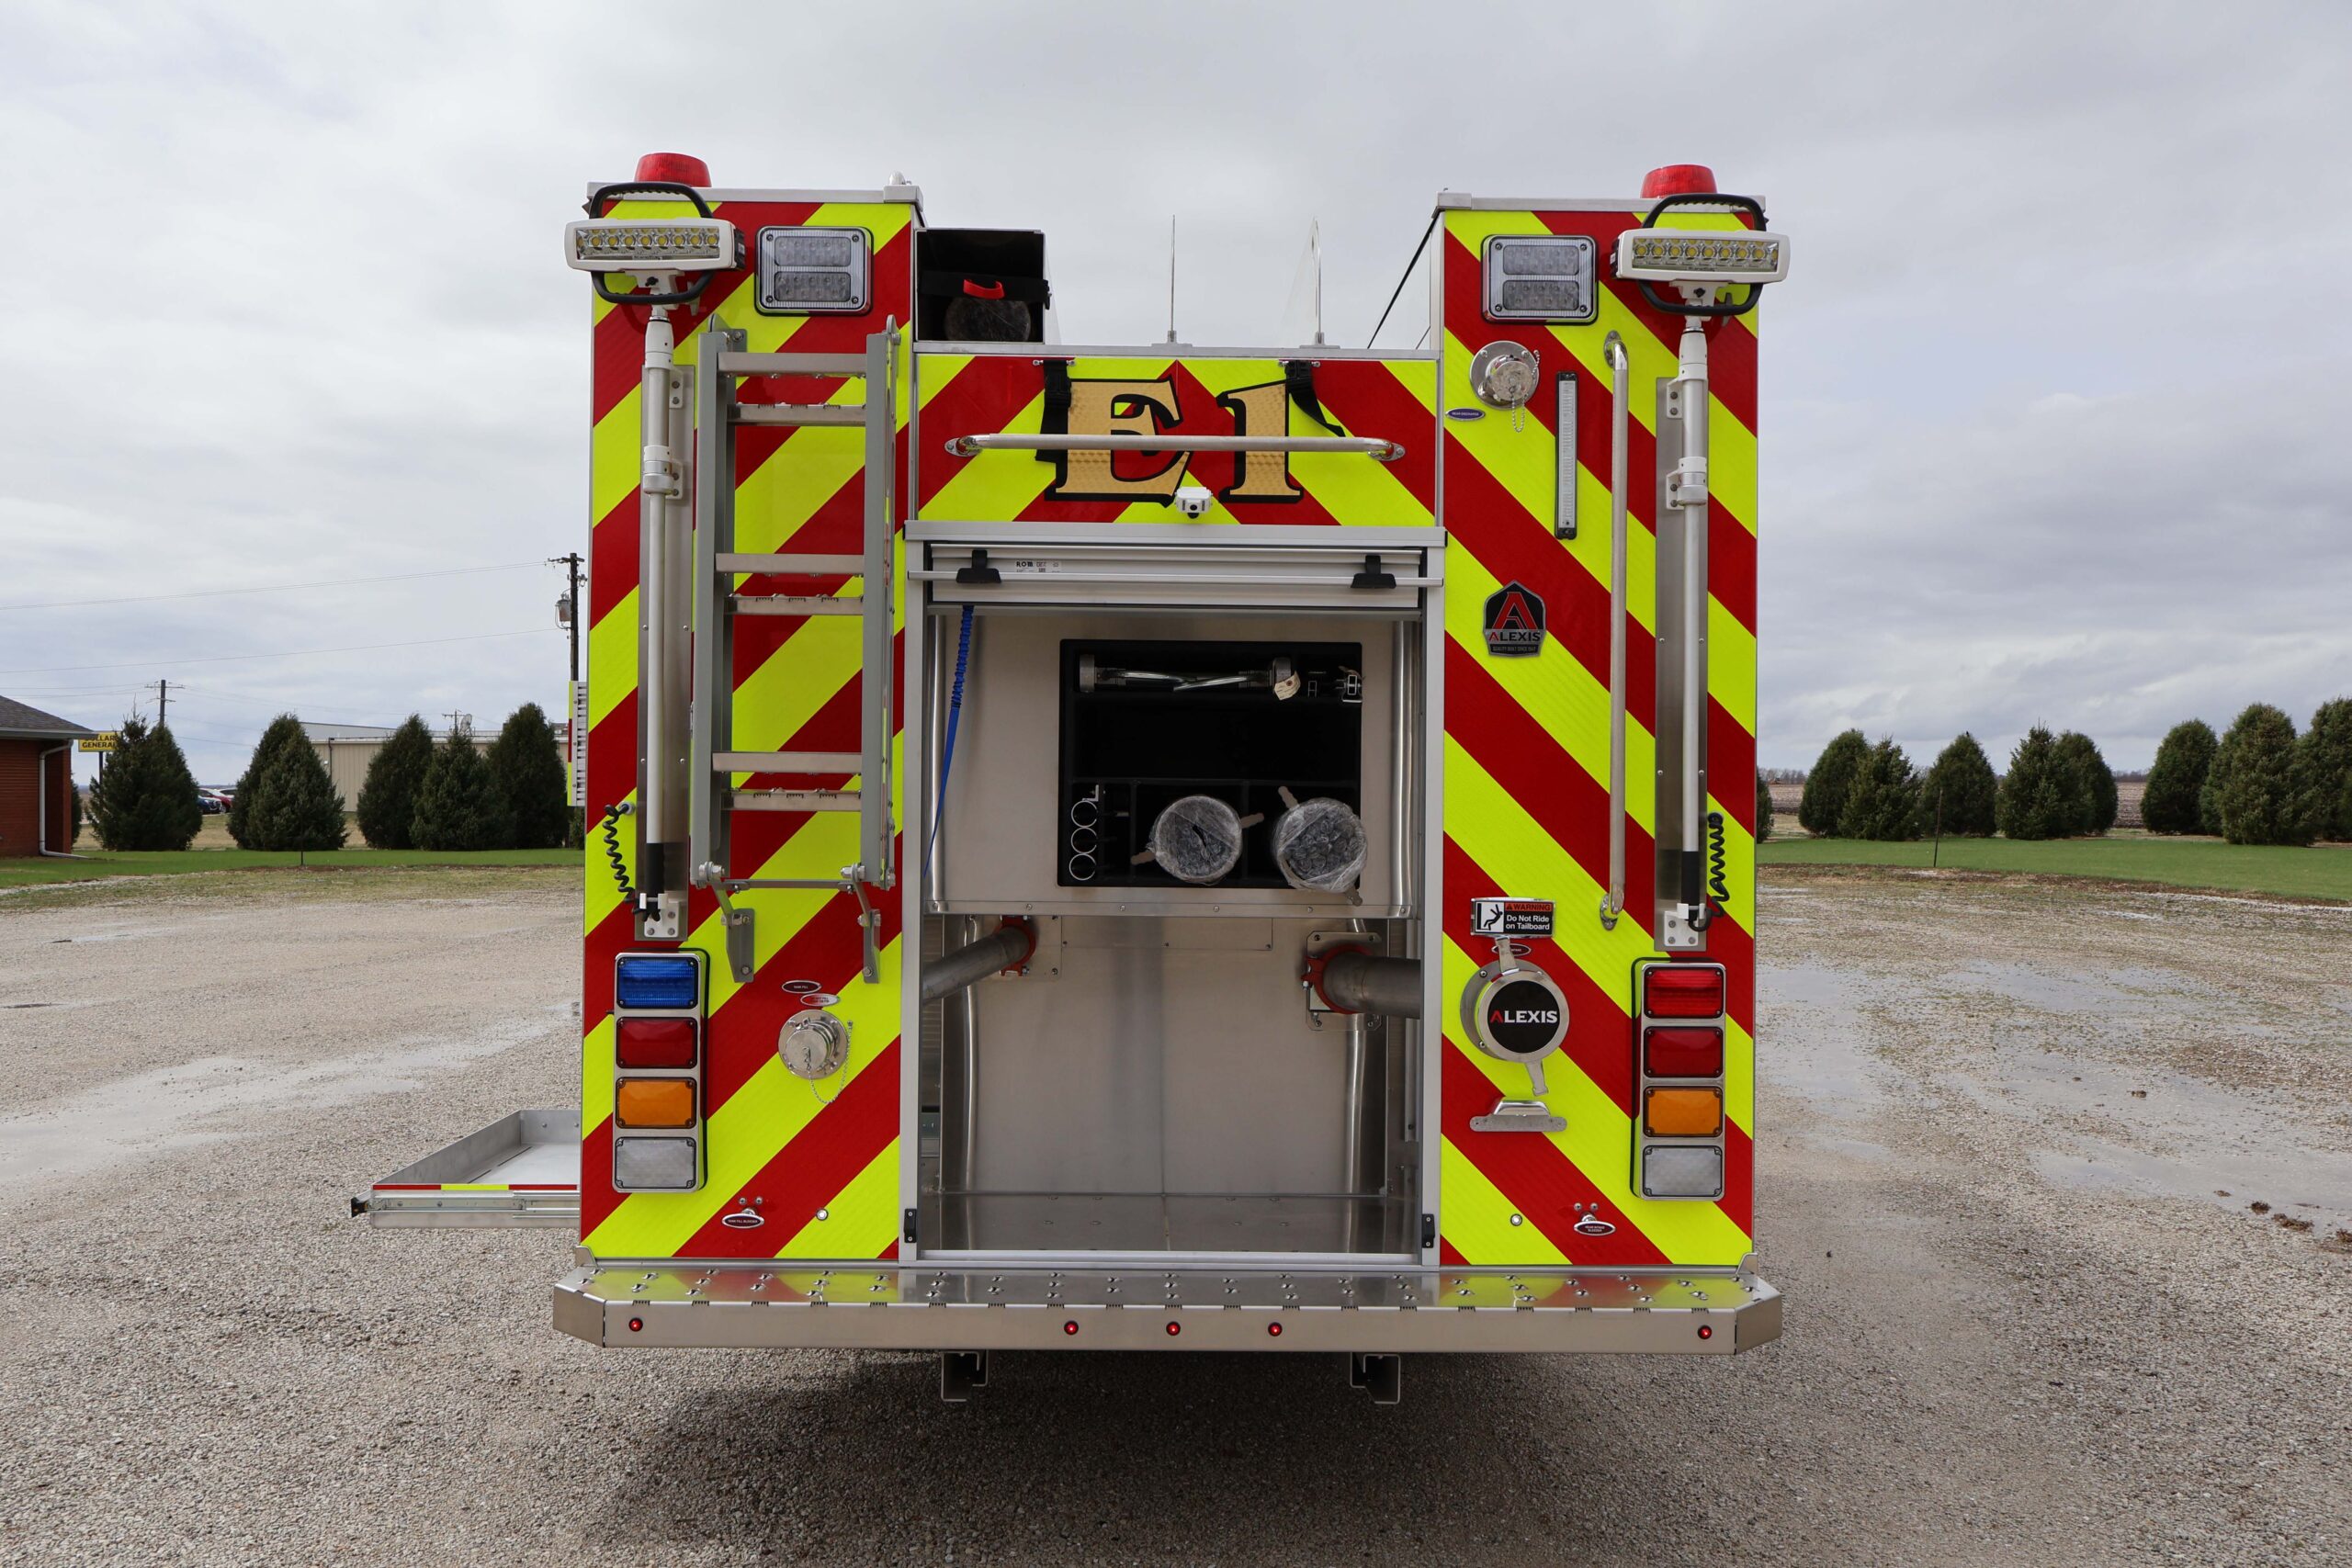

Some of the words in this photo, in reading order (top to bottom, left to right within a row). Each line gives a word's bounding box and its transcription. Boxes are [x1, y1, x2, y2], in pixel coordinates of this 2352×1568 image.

[1489, 631, 1541, 642] ALEXIS
[1513, 903, 1551, 911] WARNING
[1490, 1010, 1558, 1023] ALEXIS
